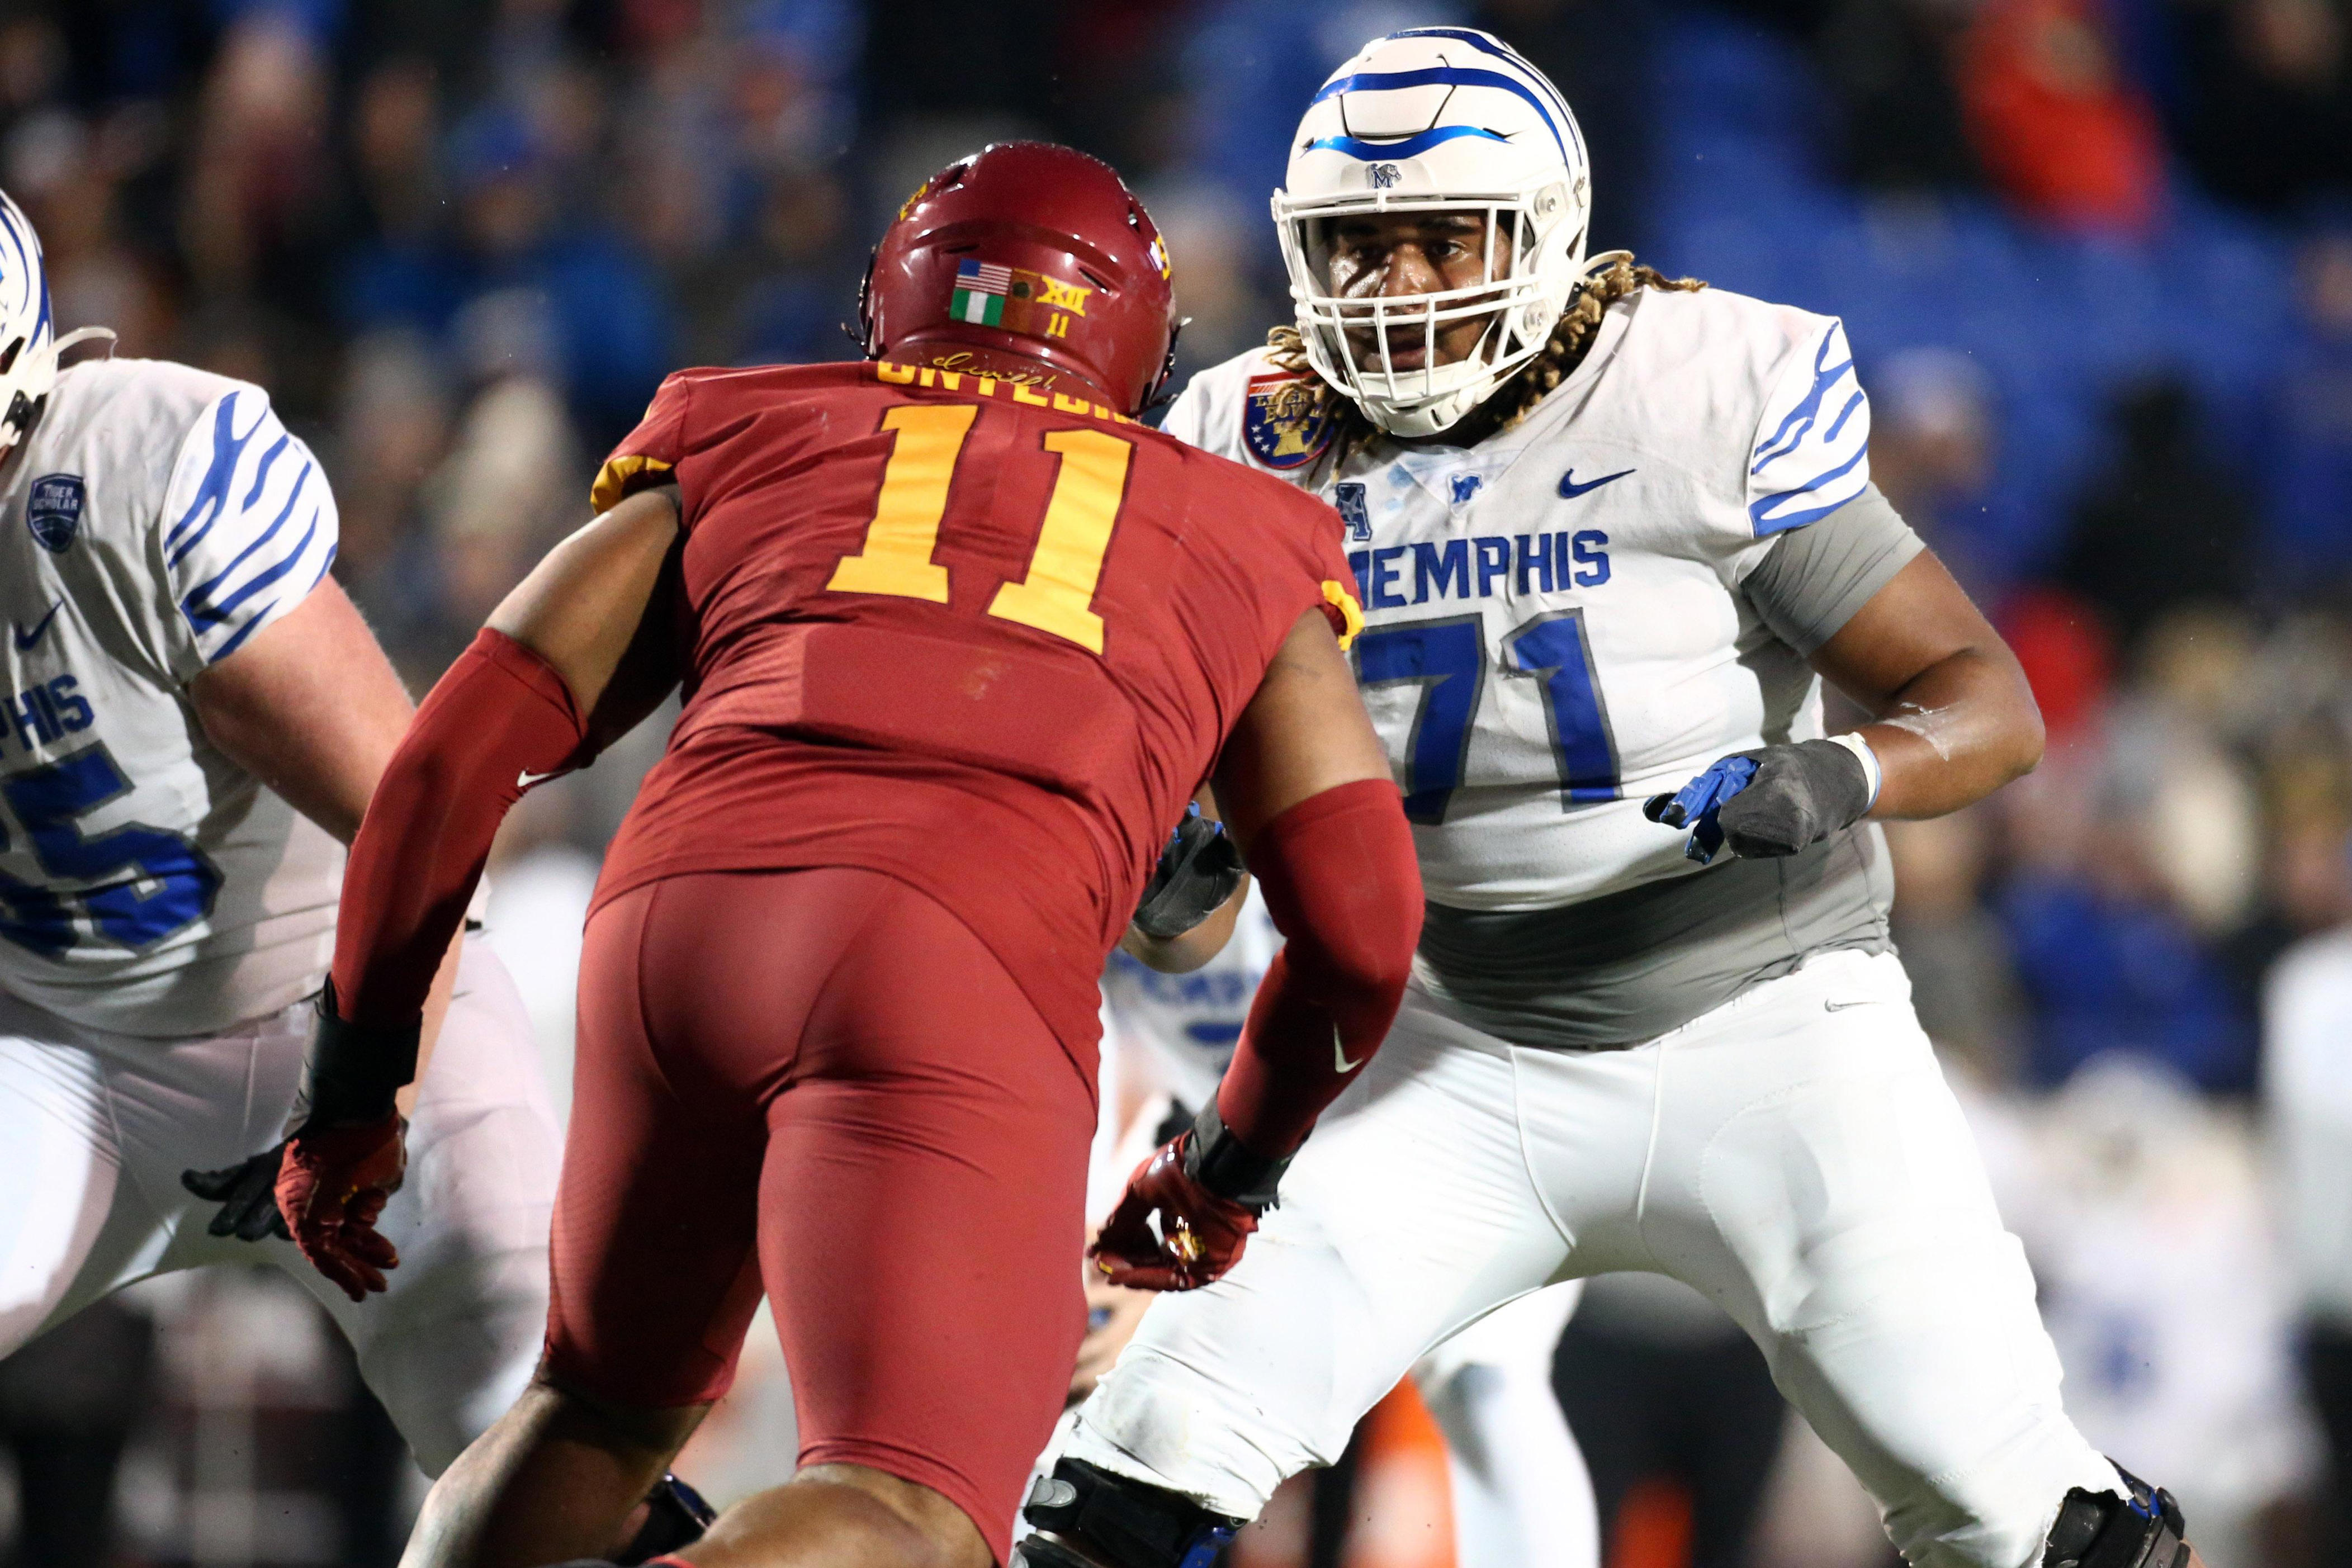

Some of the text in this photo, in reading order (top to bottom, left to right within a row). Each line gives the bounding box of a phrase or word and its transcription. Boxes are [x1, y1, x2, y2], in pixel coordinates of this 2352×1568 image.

[1046, 312, 1069, 338] 11
[825, 404, 1134, 656] 11
[1350, 607, 1623, 826] 71
